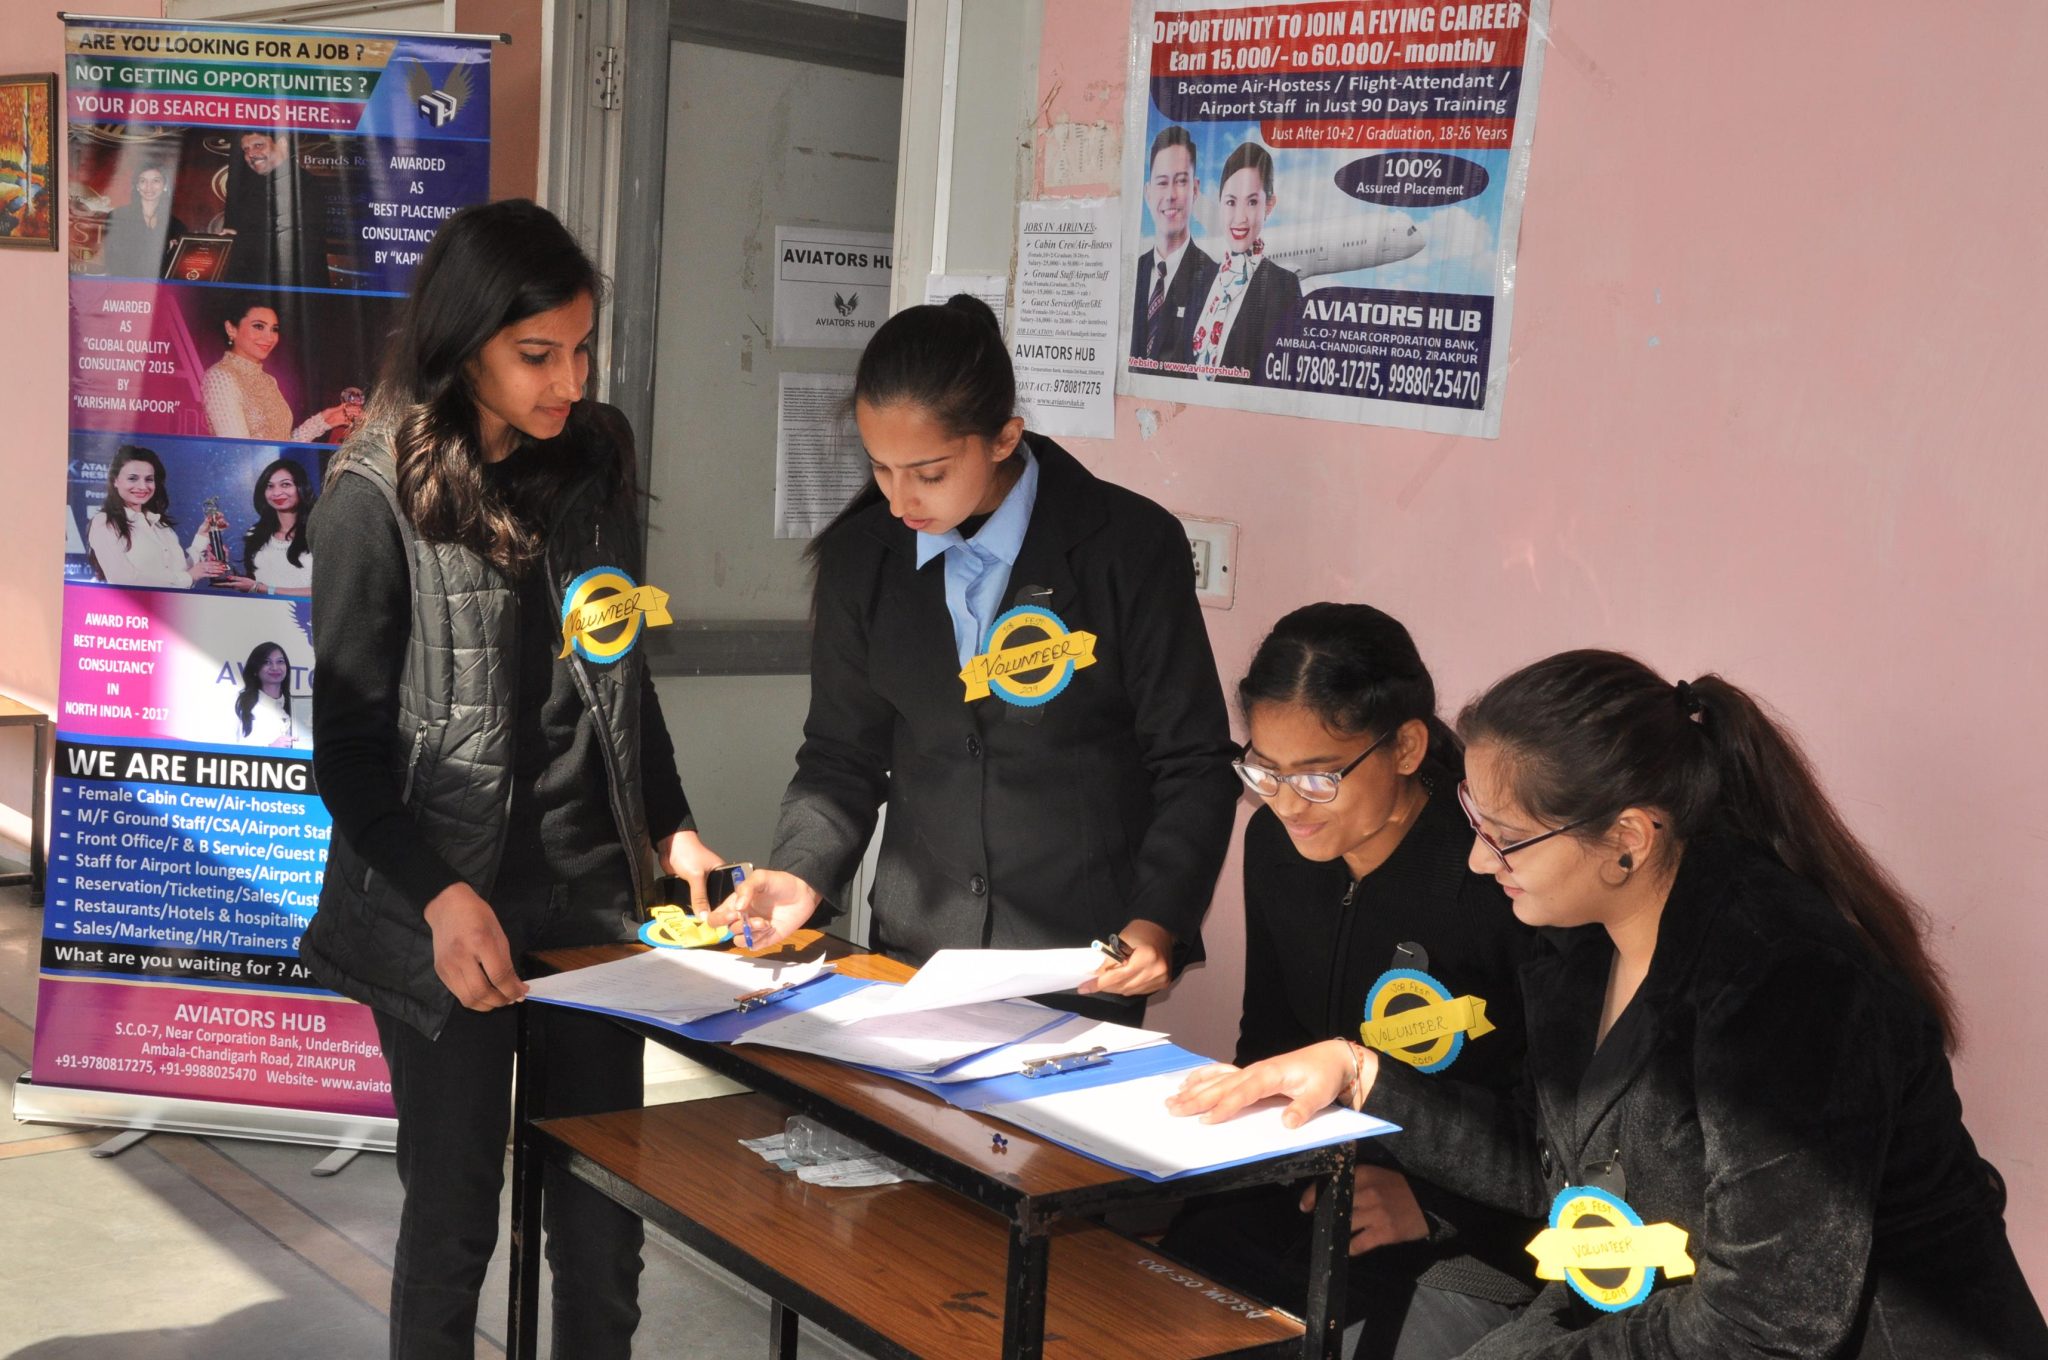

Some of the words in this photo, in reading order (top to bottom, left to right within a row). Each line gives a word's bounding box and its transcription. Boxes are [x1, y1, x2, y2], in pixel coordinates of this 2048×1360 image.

[1153, 15, 1274, 44] OPPORTUNITY
[1277, 15, 1301, 38] TO
[1305, 11, 1346, 37] JOIN
[1349, 10, 1365, 35] A
[1368, 6, 1435, 34] FLYING
[1439, 3, 1522, 31] CAREER
[79, 33, 115, 50] ARE
[121, 35, 160, 52] YOU
[165, 38, 249, 57] LOOKING
[255, 41, 291, 58] FOR
[296, 42, 311, 59] A
[314, 43, 349, 60] JOB
[1169, 51, 1207, 72] Earn
[1211, 45, 1289, 71] 15,000/-
[1292, 50, 1308, 67] to
[1311, 41, 1401, 67] 60,000/-
[1404, 37, 1496, 64] monthly
[76, 65, 115, 82] NOT
[119, 67, 198, 85] GETTING
[203, 71, 352, 92] OPPORTUNITIES
[1178, 81, 1237, 95] Become
[1241, 78, 1331, 94] Air-Hostess
[1349, 73, 1494, 94] Flight-Attendant
[76, 96, 124, 113] YOUR
[128, 98, 160, 115] JOB
[163, 100, 230, 118] SEARCH
[235, 103, 280, 121] ENDS
[1199, 101, 1256, 118] Airport
[1259, 99, 1297, 114] Staff
[1305, 100, 1320, 113] in
[1324, 99, 1357, 113] Just
[1361, 98, 1382, 113] 90
[1387, 98, 1429, 115] Days
[1434, 96, 1507, 115] Training
[1271, 127, 1293, 140] Just
[1296, 126, 1324, 140] After
[1326, 126, 1354, 140] 10+2
[1366, 126, 1435, 143] Graduation,
[1440, 126, 1471, 140] 18-26
[1476, 126, 1507, 140] Years
[303, 155, 349, 166] Brands
[390, 156, 445, 171] AWARDED
[1384, 158, 1442, 178] 100%
[409, 181, 424, 194] AS
[1356, 182, 1400, 194] Assured
[1404, 182, 1464, 196] Placement
[401, 205, 464, 219] PLACEMEN
[1024, 222, 1042, 232] JOBS
[1044, 223, 1055, 232] IN
[1034, 239, 1056, 249] Cabin
[375, 251, 387, 264] BY
[783, 249, 868, 268] AVIATORS
[873, 255, 893, 270] HU
[1032, 269, 1059, 279] Ground
[102, 300, 151, 313] AWARDED
[1031, 298, 1050, 307] Guest
[815, 318, 855, 328] AVIATORS
[857, 320, 876, 328] HUB
[1302, 299, 1423, 328] AVIATORS
[1428, 308, 1482, 332] HUB
[120, 320, 132, 333] AS
[126, 340, 170, 354] QUALITY
[1303, 327, 1338, 339] S.C.O-7
[1340, 330, 1367, 342] NEAR
[1368, 332, 1441, 348] CORPORATION
[1445, 339, 1479, 352] BANK,
[1015, 344, 1073, 360] AVIATORS
[1075, 347, 1096, 361] HUB
[1276, 337, 1387, 357] AMBALA-CHANDIGARH
[1391, 347, 1422, 360] ROAD,
[1426, 351, 1478, 364] ZIRAKPUR
[78, 357, 146, 372] CONSULTANCY
[148, 361, 175, 374] 2015
[1164, 362, 1250, 378] www.aviatorshub.in
[117, 378, 129, 391] BY
[1054, 379, 1101, 395] 9780817275
[1265, 353, 1292, 382] Cell.
[1296, 355, 1384, 397] 97808-17275,
[1389, 364, 1480, 401] 99880-25470
[85, 612, 123, 628] AWARD
[126, 615, 149, 630] FOR
[569, 592, 644, 633] VOLUNTEER
[73, 634, 95, 648] BEST
[97, 635, 164, 653] PLACEMENT
[79, 657, 155, 675] CONSULTANCY
[980, 640, 1082, 678] VOLUNTEER
[107, 683, 120, 696] IN
[65, 701, 98, 717] NORTH
[100, 705, 132, 719] INDIA
[142, 707, 170, 721] 2017
[68, 748, 116, 778] WE
[125, 753, 188, 783] ARE
[196, 757, 307, 791] HIRING
[78, 786, 133, 802] Female
[136, 789, 177, 806] Cabin
[181, 792, 305, 815] Crew/Air-hostess
[78, 808, 109, 826] M/F
[113, 811, 168, 827] Ground
[171, 814, 300, 839] Staff/CSA/Airport
[76, 831, 117, 846] Front
[121, 833, 179, 853] Office/F
[182, 838, 195, 852] &
[199, 840, 209, 853] B
[213, 840, 315, 861] Service/Guest
[75, 853, 112, 868] Staff
[115, 855, 137, 870] for
[140, 857, 191, 875] Airport
[195, 861, 311, 885] lounges/Airport
[74, 898, 215, 921] Restaurants/Hotels
[218, 908, 231, 922] &
[73, 920, 288, 949] Sales/Marketing/HR/Trainers
[55, 946, 103, 963] What
[108, 952, 135, 965] are
[140, 955, 172, 969] you
[177, 956, 242, 976] waiting
[246, 960, 272, 975] for
[174, 1004, 275, 1029] AVIATORS
[282, 1012, 326, 1033] HUB
[115, 1022, 162, 1040] S.C.O-7,
[165, 1026, 193, 1041] Near
[196, 1028, 266, 1046] Corporation
[269, 1034, 302, 1051] Bank,
[305, 1037, 383, 1058] UnderBridge,
[1371, 1016, 1448, 1046] VOLUNTEER
[141, 1042, 257, 1064] Ambala-Chandigarh
[260, 1052, 293, 1069] Road,
[296, 1055, 356, 1072] ZIRAKPUR
[55, 1054, 156, 1076] +91-9780817275,
[159, 1063, 257, 1082] +91-9988025470
[266, 1070, 318, 1087] Website-
[321, 1078, 392, 1094] www.aviato
[1592, 1200, 1612, 1214] FEST
[1572, 1237, 1632, 1259] VOLUNTEER
[1602, 1287, 1628, 1301] 2019
